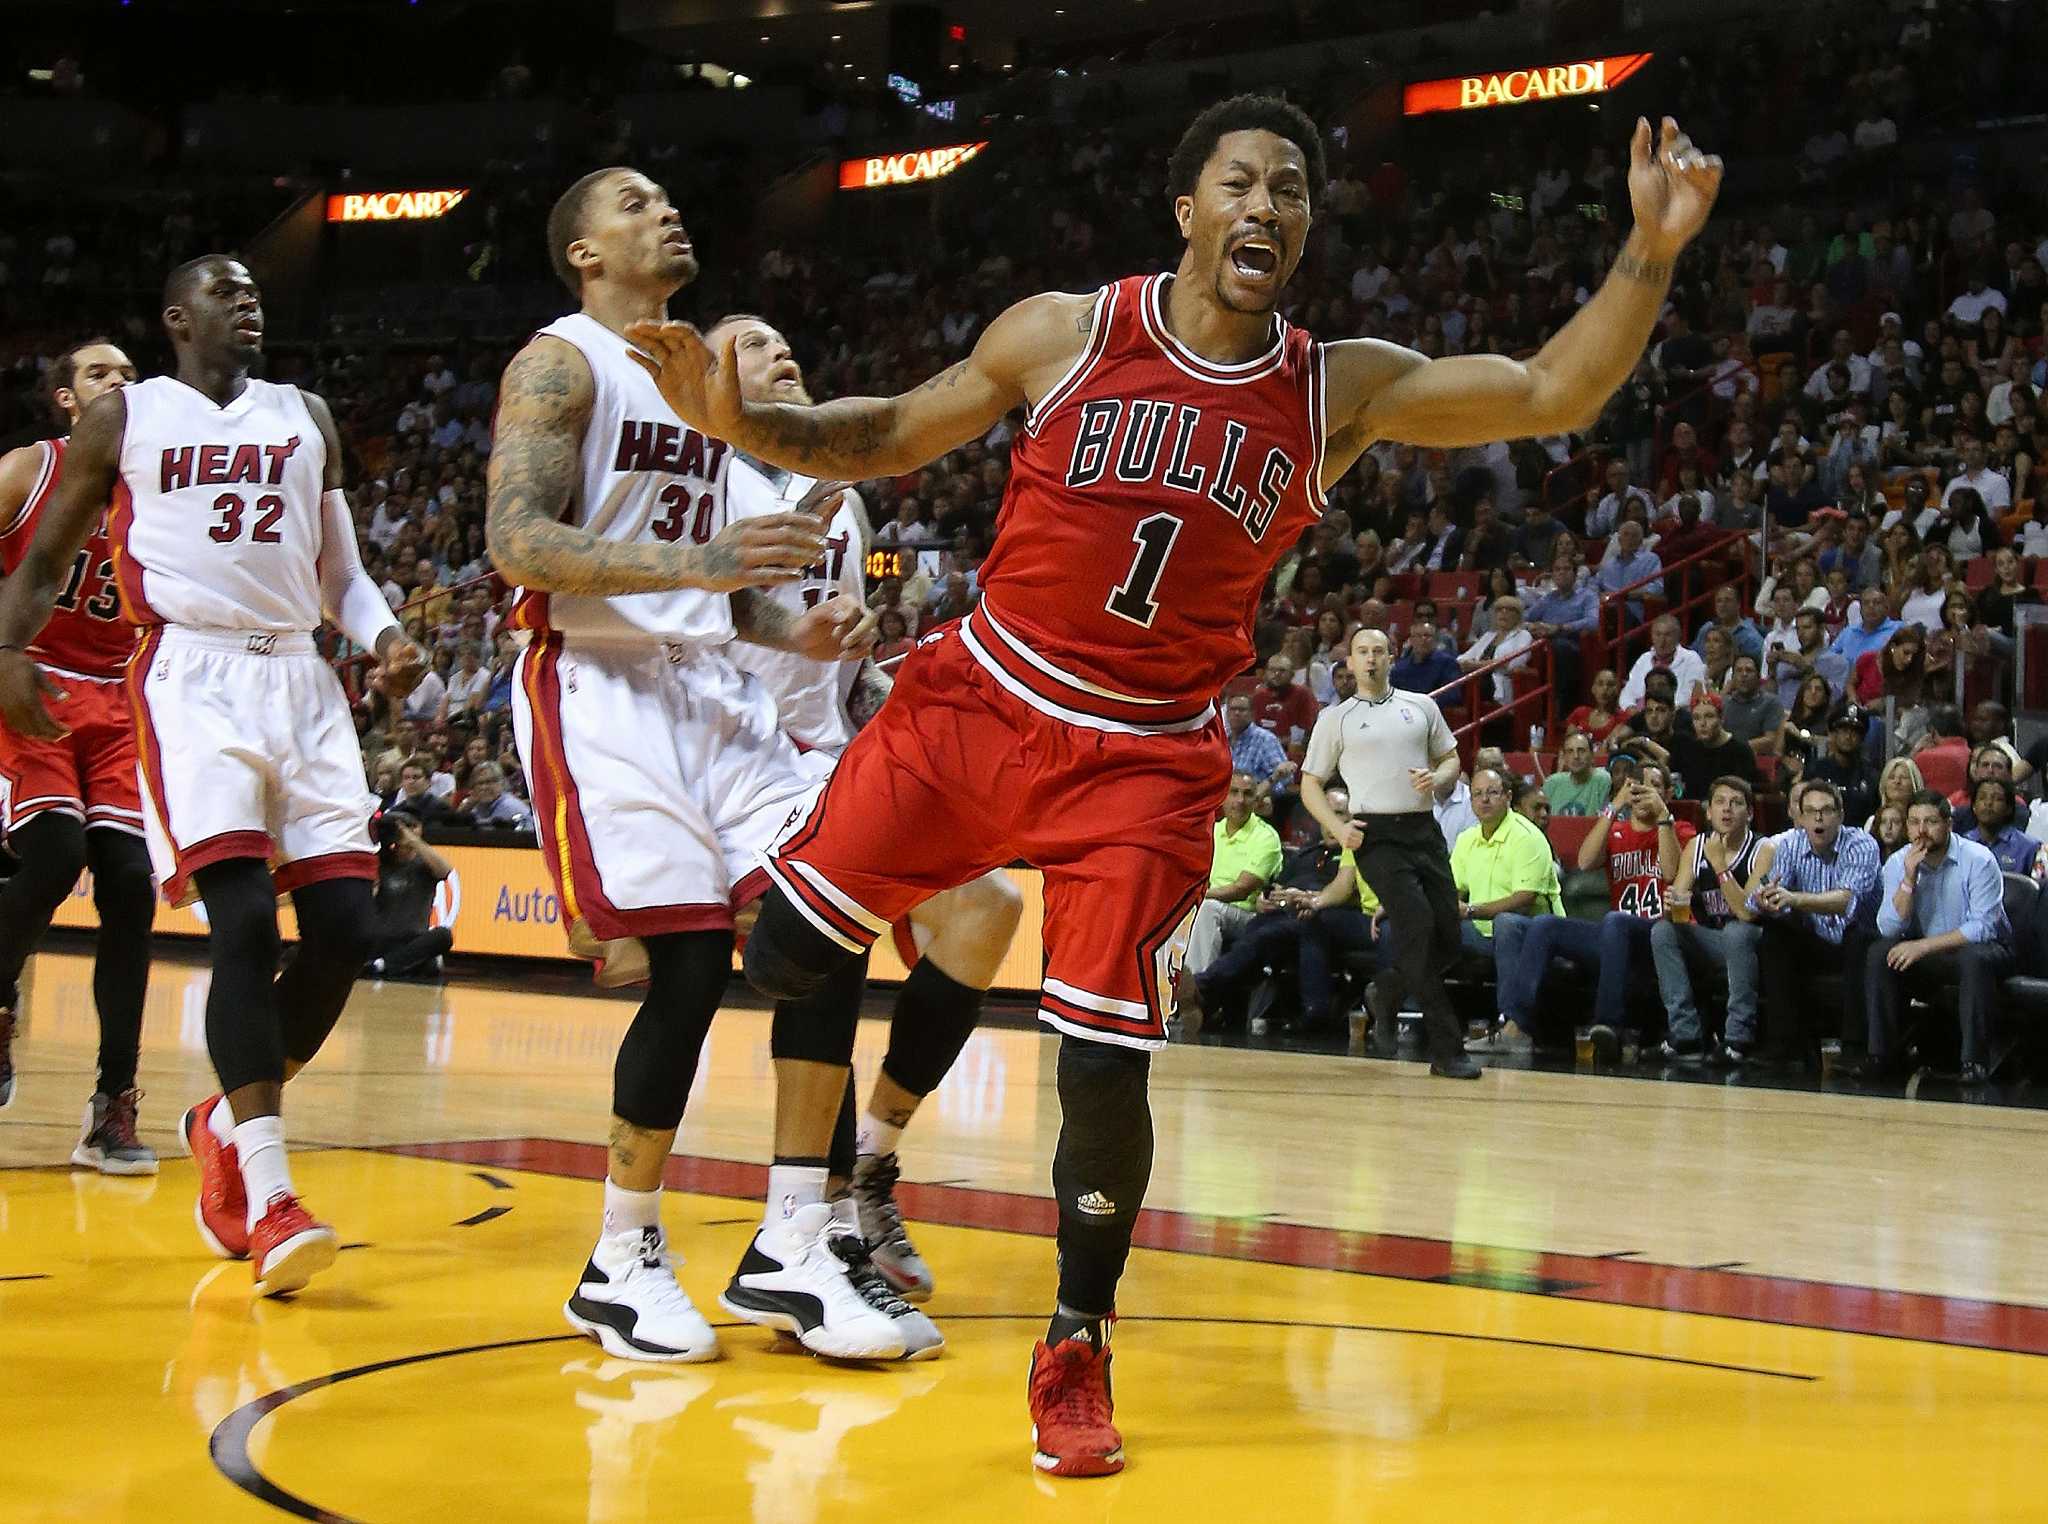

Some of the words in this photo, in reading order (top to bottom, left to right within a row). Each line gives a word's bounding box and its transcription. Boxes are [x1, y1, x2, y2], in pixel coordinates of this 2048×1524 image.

[1461, 62, 1606, 107] BACARDI
[160, 434, 301, 493] HEAT
[614, 420, 728, 483] HEAT
[1066, 399, 1296, 544] BULLS
[208, 493, 284, 543] 32
[651, 484, 714, 545] 30
[54, 549, 121, 623] 13
[1104, 512, 1184, 630] 1
[494, 884, 561, 924] Auto
[1618, 878, 1664, 919] 44
